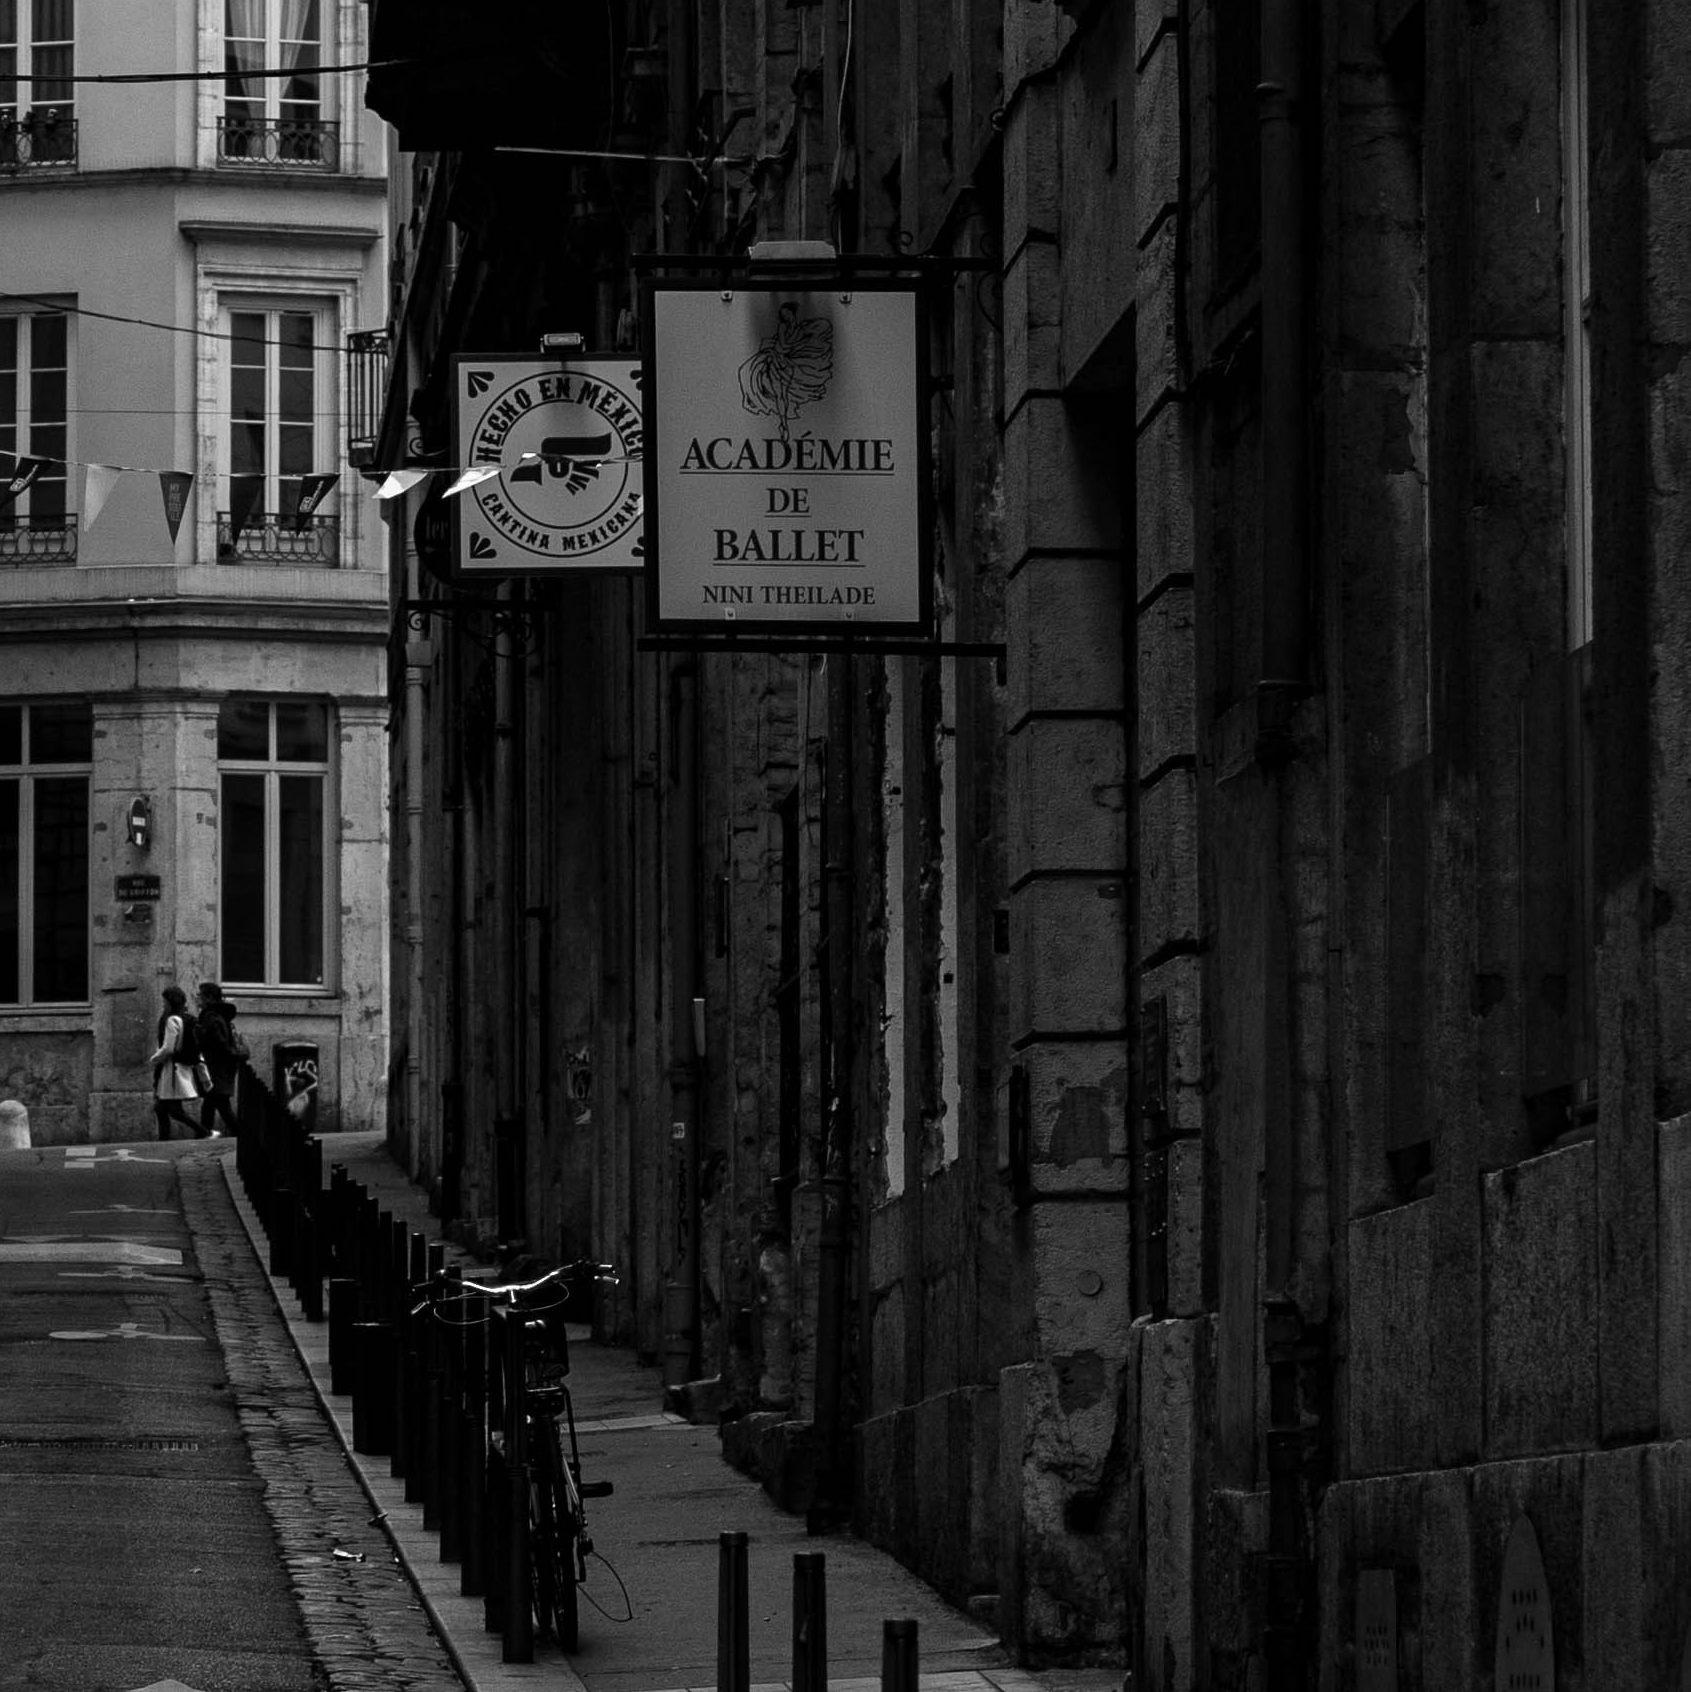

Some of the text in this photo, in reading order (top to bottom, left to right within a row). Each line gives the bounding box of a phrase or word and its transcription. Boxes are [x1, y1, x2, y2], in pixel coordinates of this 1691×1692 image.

[475, 387, 533, 464] HECHO
[538, 376, 571, 401] EN
[679, 431, 896, 471] ACADÉMIE
[766, 487, 811, 513] DE
[481, 492, 550, 550] CANTINA
[561, 491, 641, 552] MEXICANA
[712, 528, 865, 562] BALLET
[702, 585, 877, 606] NINI THEILADE
